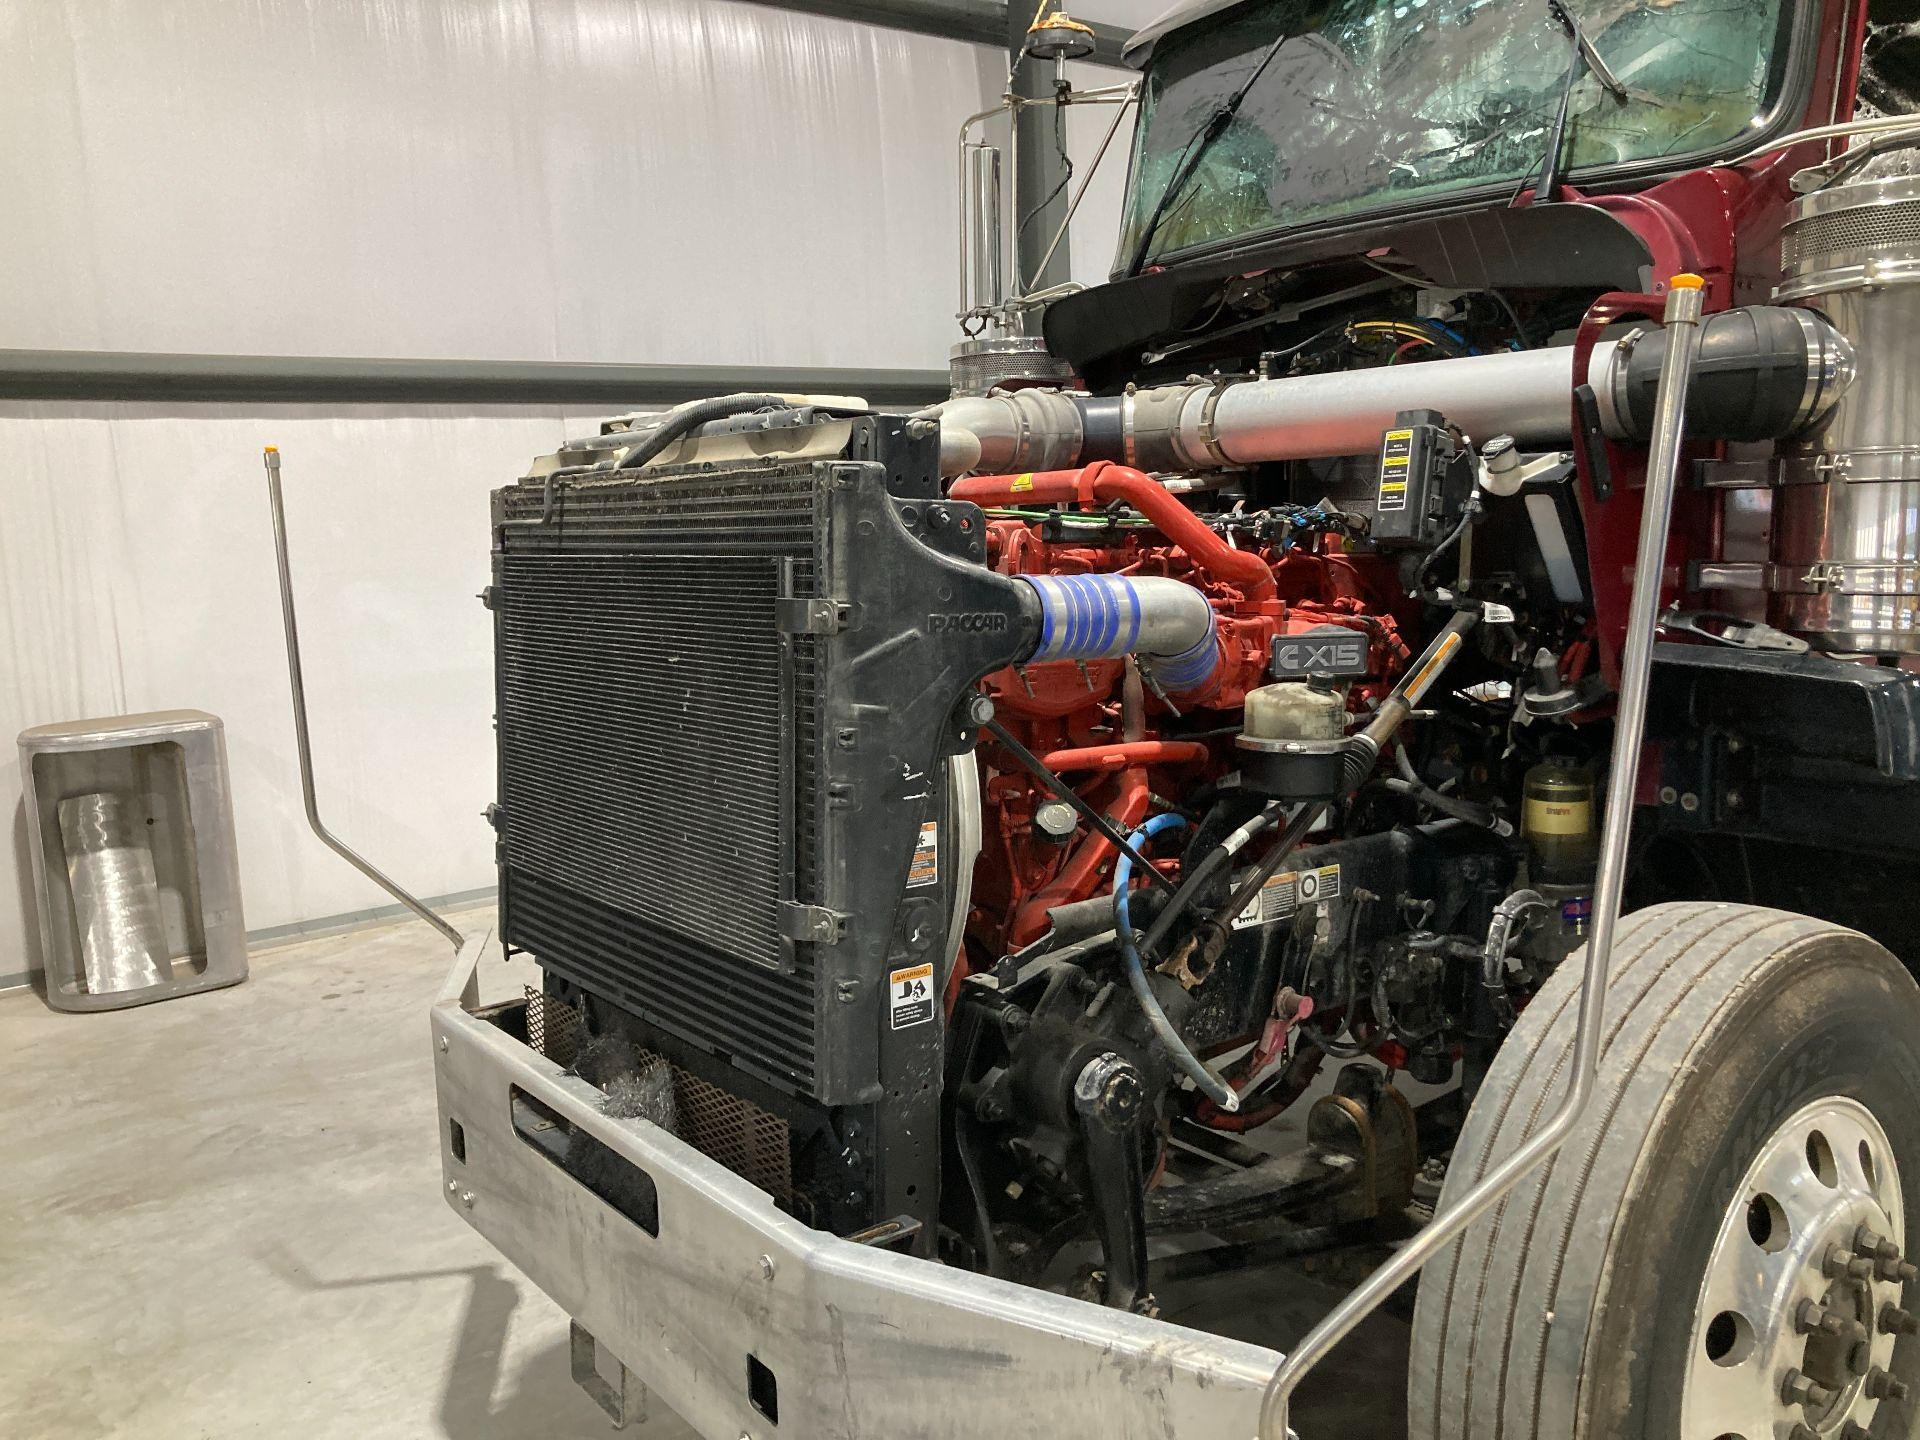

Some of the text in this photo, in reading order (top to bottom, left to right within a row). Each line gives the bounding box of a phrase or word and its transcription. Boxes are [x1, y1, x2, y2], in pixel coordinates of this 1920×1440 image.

[928, 613, 1007, 632] PACCAR
[1304, 645, 1359, 668] X15
[901, 969, 928, 979] WARNING
